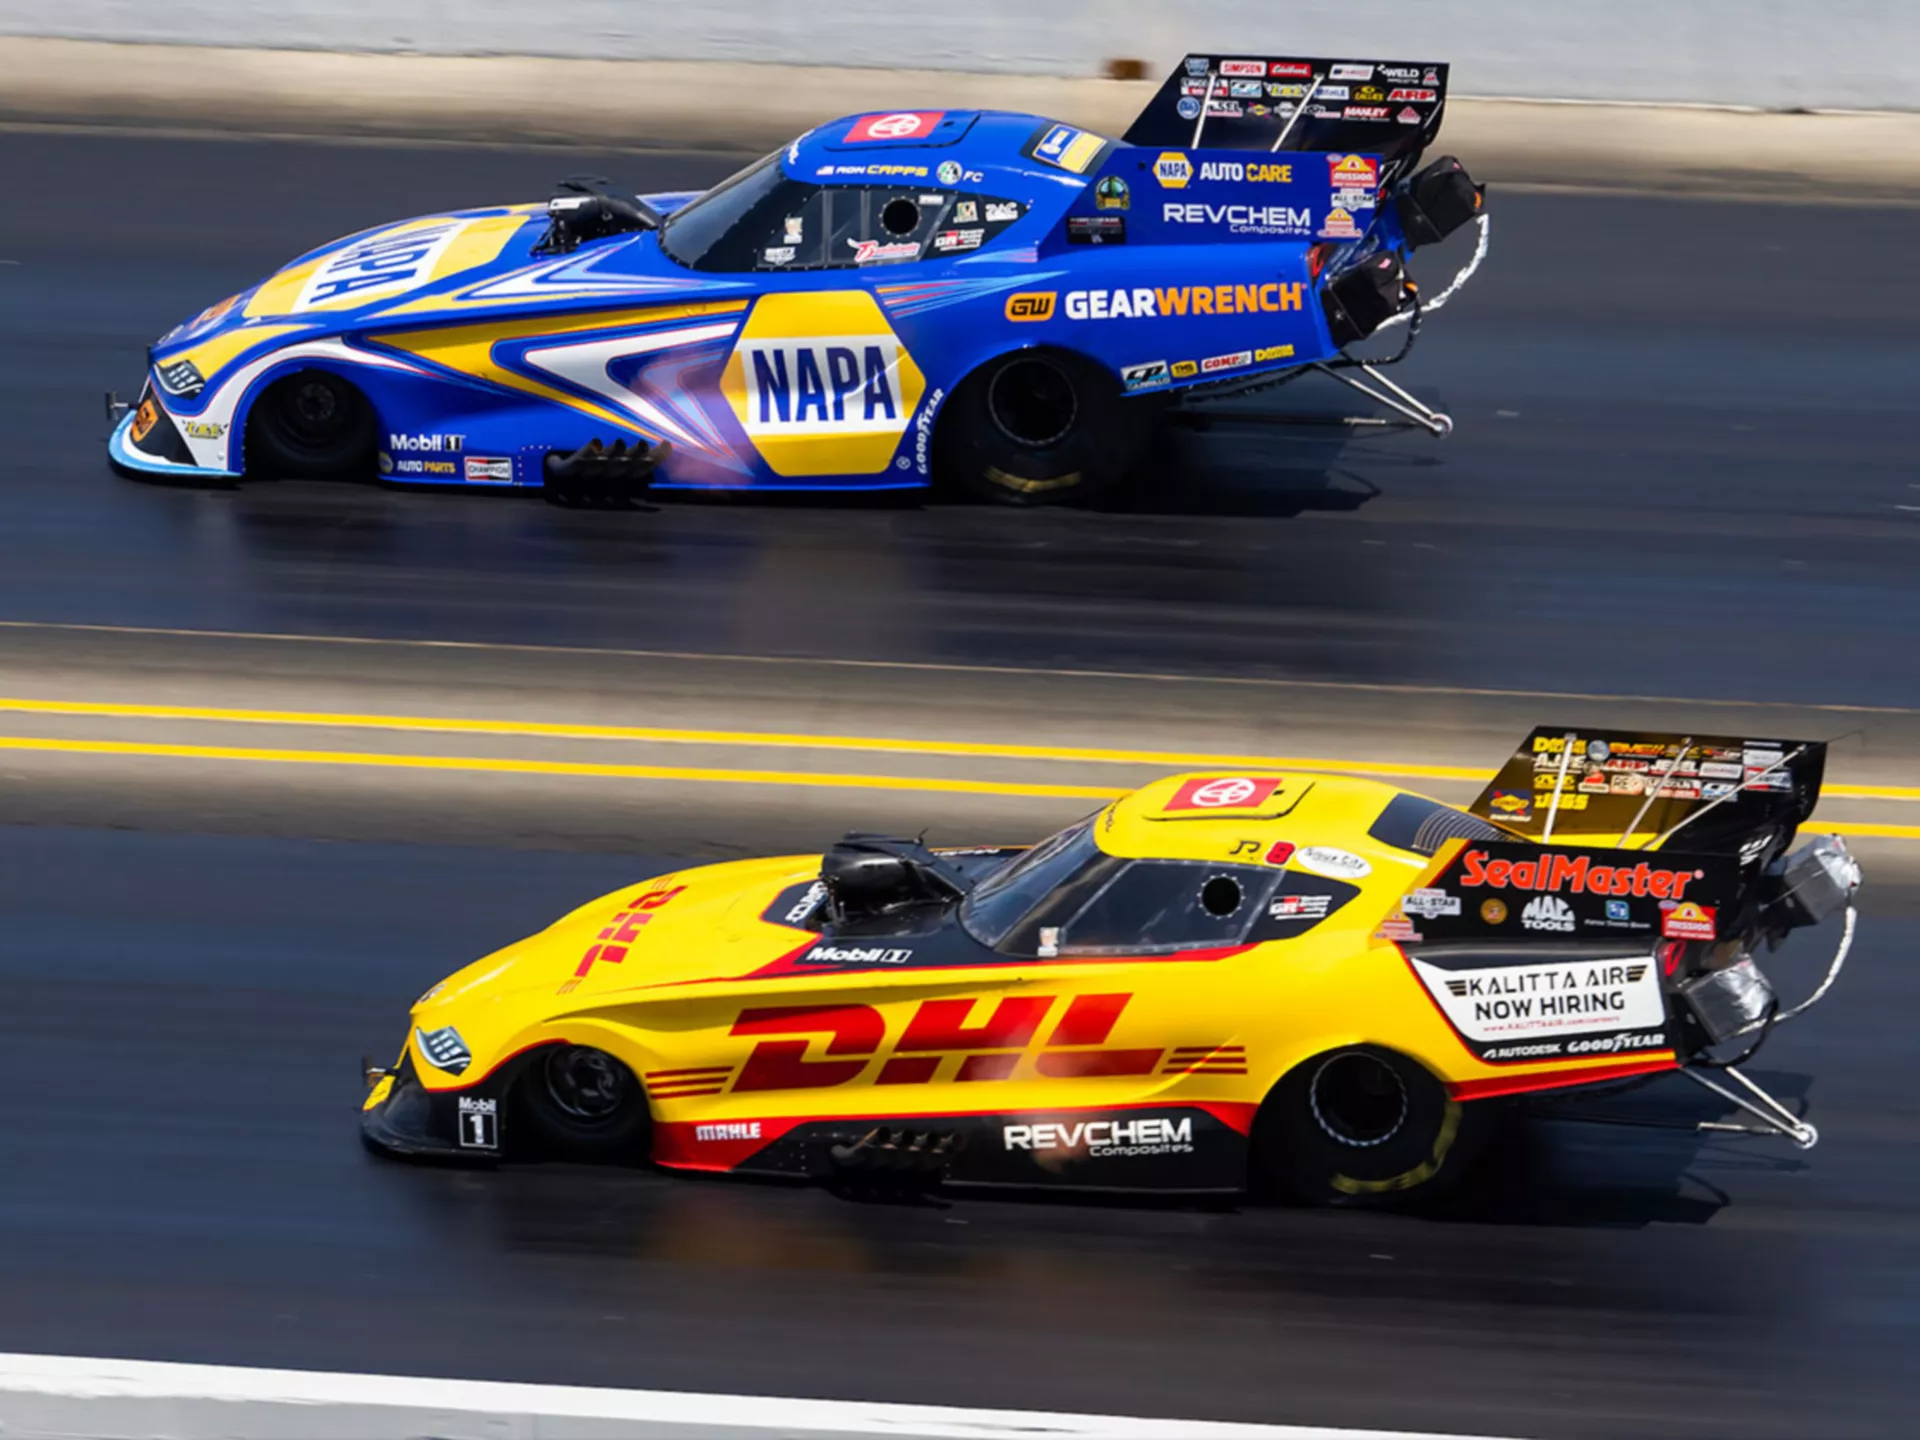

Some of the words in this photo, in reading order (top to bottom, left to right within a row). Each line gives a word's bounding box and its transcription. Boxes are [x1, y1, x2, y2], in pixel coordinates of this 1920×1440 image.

[1385, 67, 1419, 78] WELD
[1344, 106, 1388, 118] MANLEY
[836, 165, 865, 175] RON
[867, 164, 929, 177] CAPPS
[963, 170, 984, 183] FC
[1159, 162, 1189, 179] NAPA
[1200, 162, 1243, 182] AUTO
[1246, 163, 1292, 183] CARE
[1162, 203, 1312, 227] REVCHEM
[1229, 223, 1312, 236] Composites
[1010, 297, 1051, 316] GW
[1065, 282, 1302, 320] GEARWRENCH
[1203, 355, 1241, 370] COMP
[751, 345, 897, 424] NAPA
[916, 387, 946, 475] GOODYEAR
[389, 433, 442, 452] Mobil
[397, 460, 423, 473] AUTO
[424, 461, 456, 474] PARTS
[1460, 850, 1692, 900] SealMaster
[1521, 895, 1576, 921] MAC
[574, 885, 689, 978] DHL
[1521, 919, 1576, 932] TOOLS
[805, 947, 884, 963] Mobil
[1468, 971, 1578, 997] KALITTA
[1585, 966, 1625, 988] AIR
[1474, 997, 1534, 1021] NOW
[1540, 990, 1625, 1018] HIRING
[728, 992, 1165, 1093] DHL
[1499, 1043, 1562, 1058] AUTODESK
[1567, 1032, 1666, 1053] GOODYEAR
[458, 1096, 497, 1113] Mobil
[695, 1122, 762, 1142] MAHLE
[1003, 1117, 1194, 1151] REVCHEM
[1088, 1141, 1195, 1158] Composites
